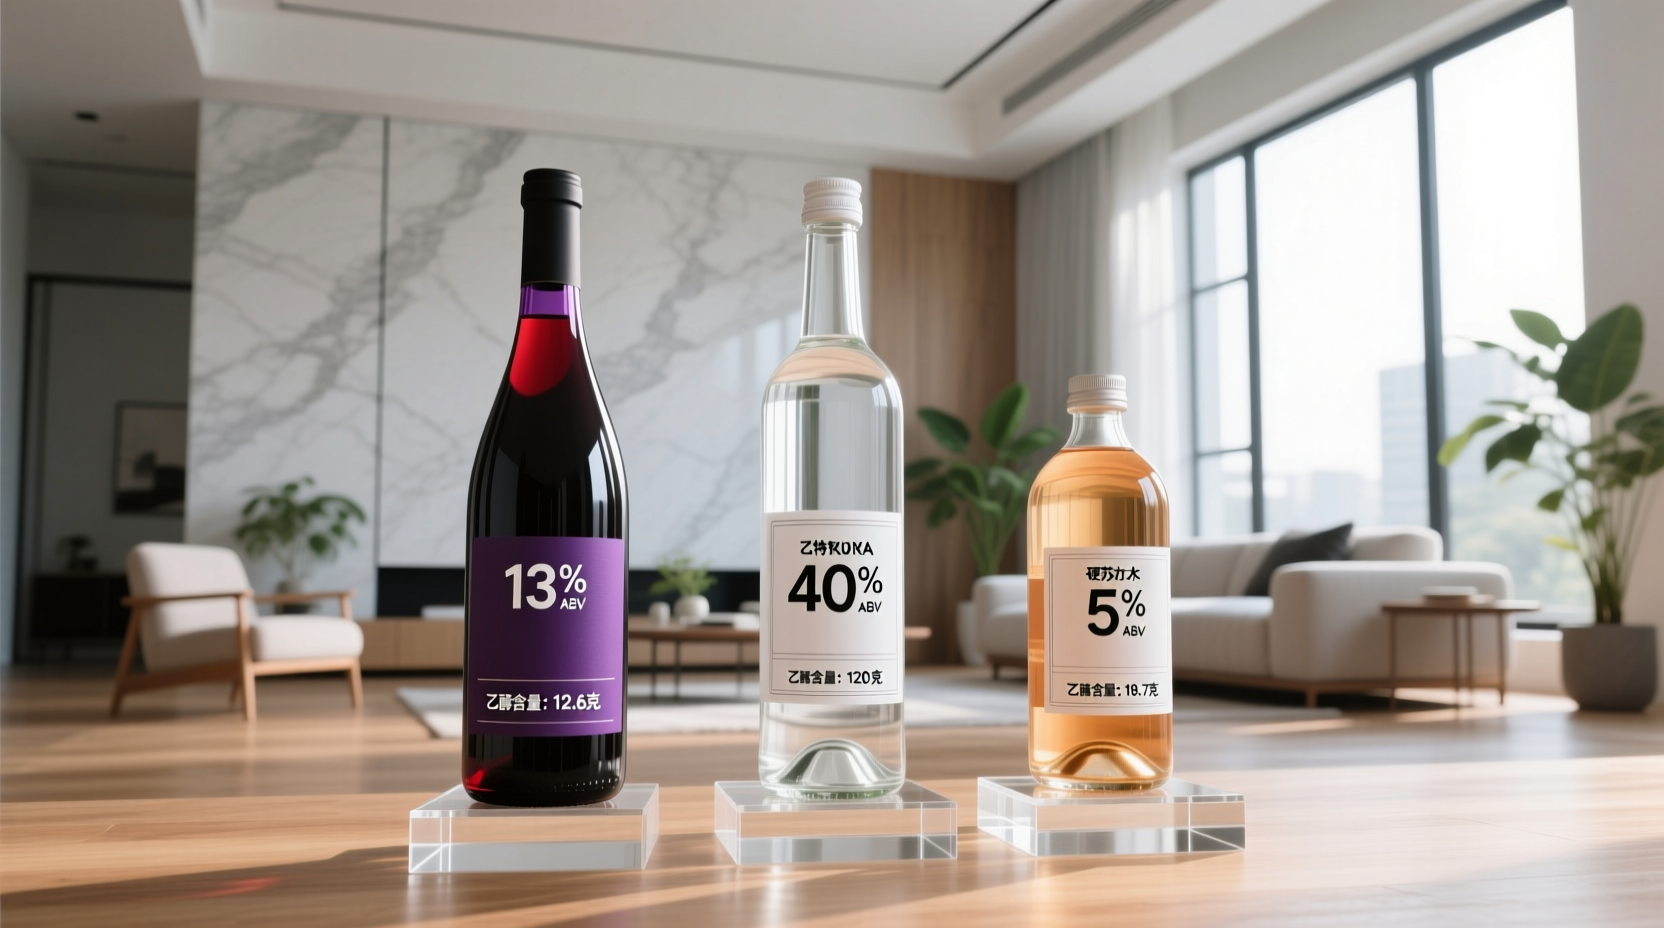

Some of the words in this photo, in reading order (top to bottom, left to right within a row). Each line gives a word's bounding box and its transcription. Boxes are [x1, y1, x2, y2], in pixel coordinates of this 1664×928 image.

[504, 562, 588, 611] 13%
[787, 563, 883, 614] 40%
[857, 600, 883, 613] ABV
[1087, 588, 1146, 637] 5%
[1122, 625, 1147, 637] ABV
